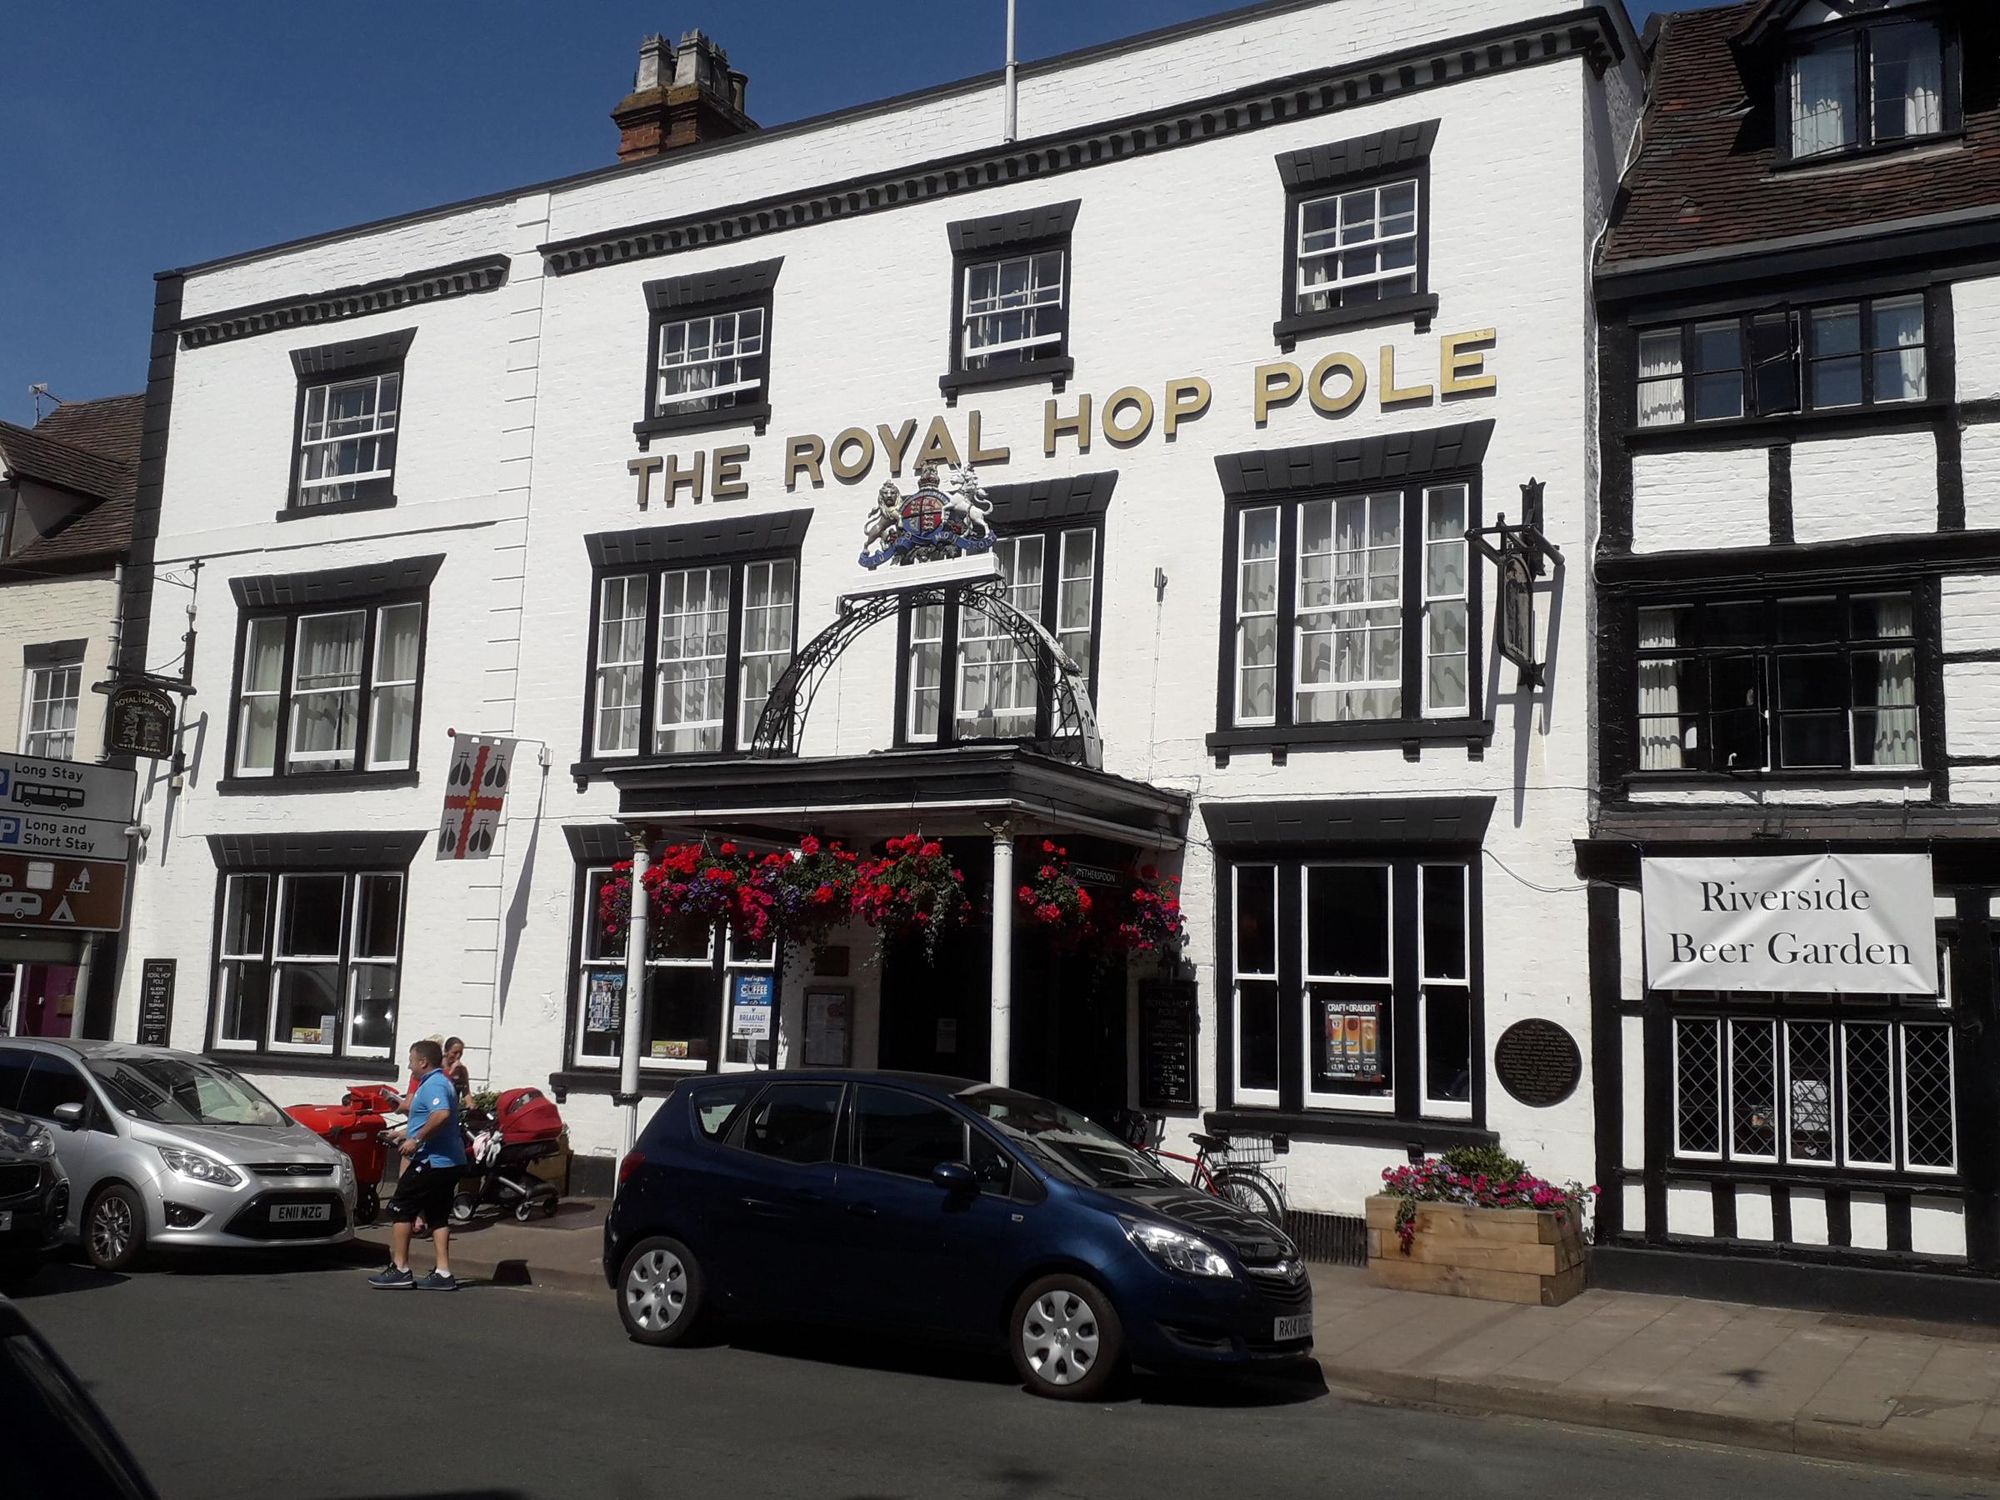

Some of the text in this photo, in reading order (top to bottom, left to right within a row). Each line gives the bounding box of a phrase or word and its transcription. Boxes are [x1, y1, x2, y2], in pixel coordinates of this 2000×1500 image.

[627, 327, 1498, 508] THE ROYAL HOP POLE
[114, 696, 138, 706] ROYAL
[154, 701, 171, 717] POLE
[14, 761, 47, 779] Long
[52, 766, 84, 783] Stay
[25, 818, 87, 836] Long and
[23, 833, 96, 853] Short Stay
[1699, 878, 1871, 912] Riverside
[1668, 931, 1912, 966] Beer Garden
[740, 983, 768, 996] COFFEE
[739, 1014, 766, 1022] BREAKFAST
[1327, 1003, 1377, 1014] CRAFT DRAUGHT
[300, 1206, 322, 1219] MZG
